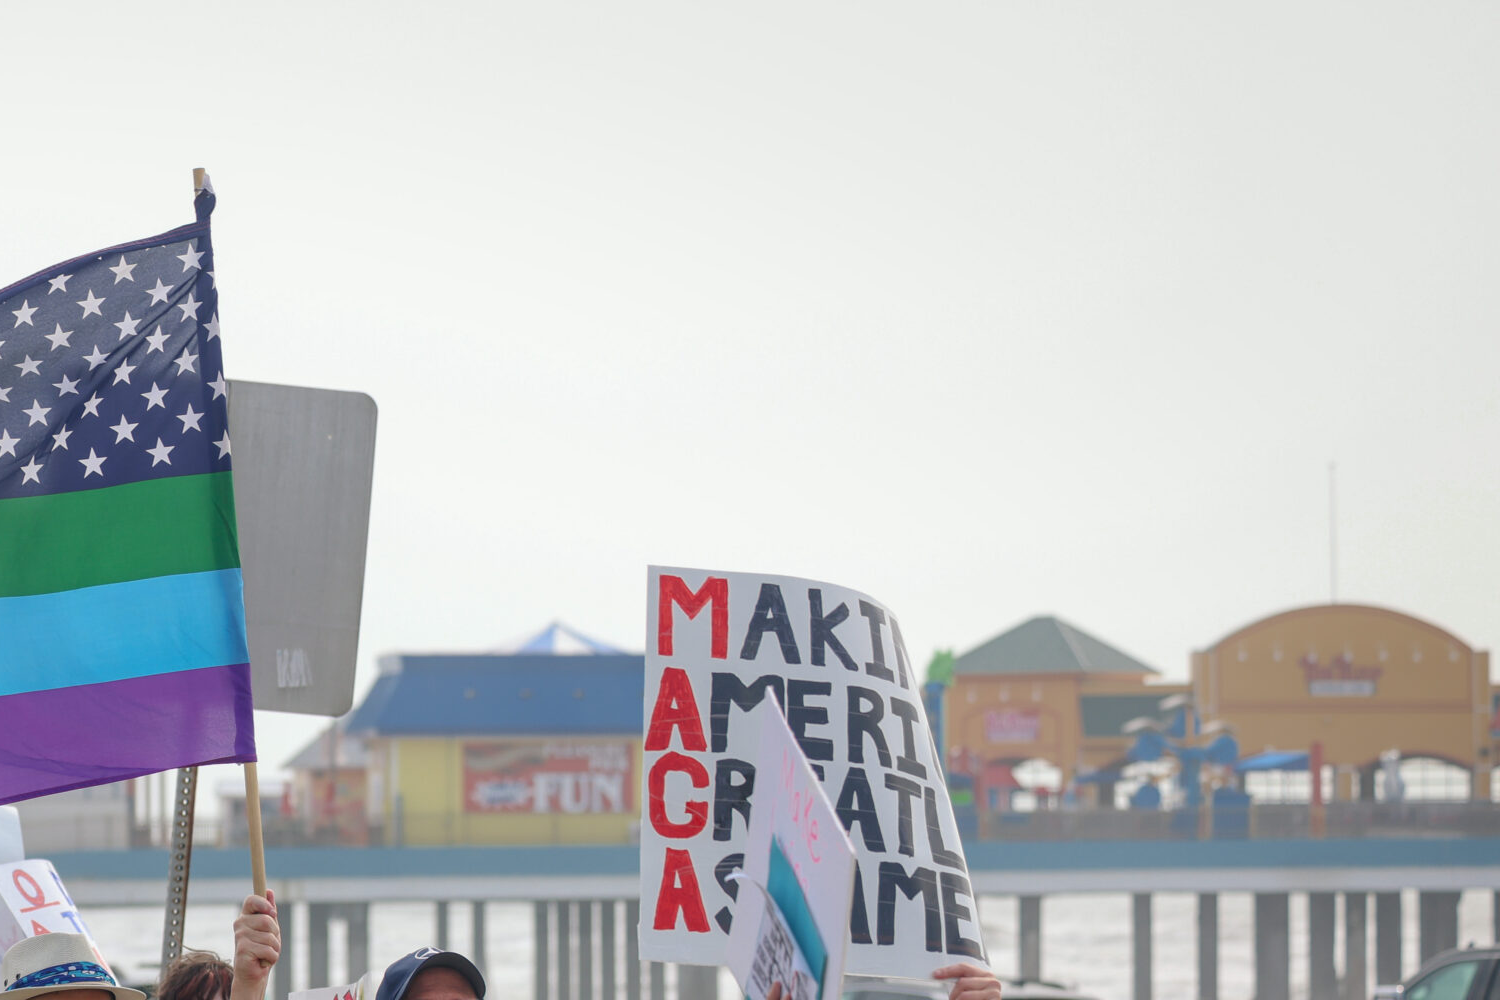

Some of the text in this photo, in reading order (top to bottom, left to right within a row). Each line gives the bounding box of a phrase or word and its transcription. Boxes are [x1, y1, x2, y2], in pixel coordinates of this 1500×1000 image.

[644, 667, 940, 780] AMERI
[533, 772, 623, 814] FUN
[648, 751, 966, 873] GRATL
